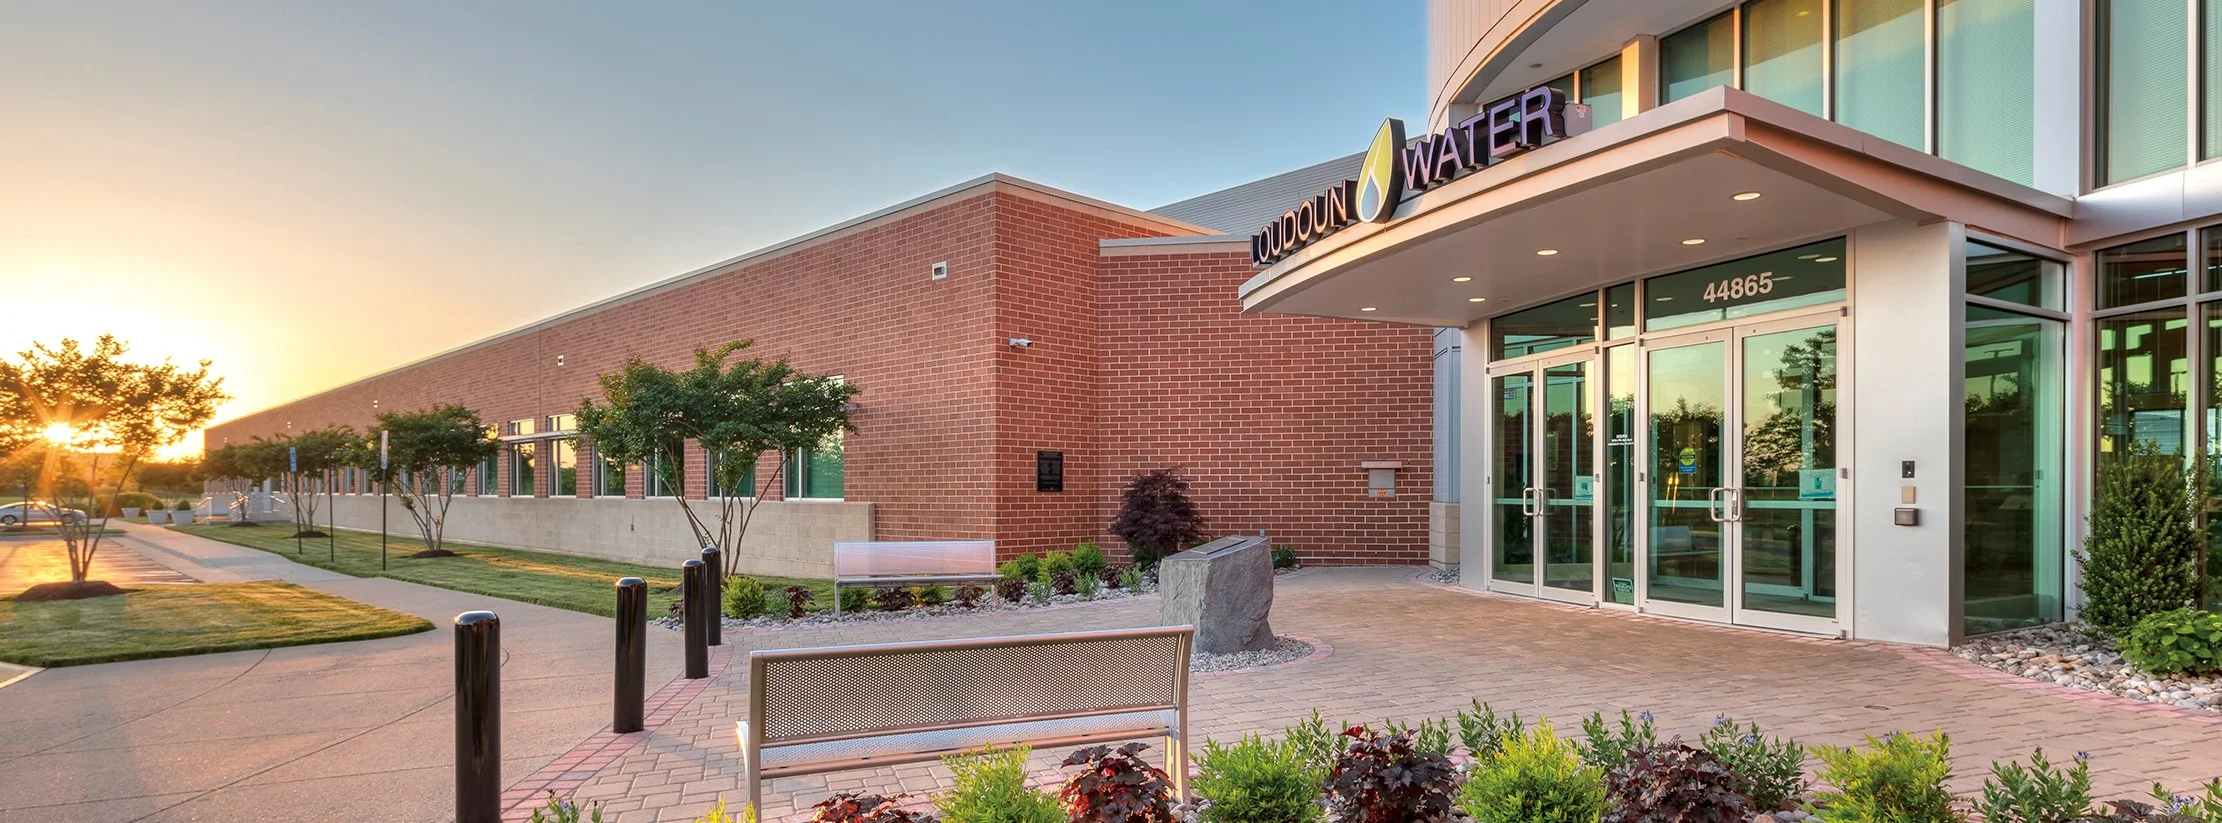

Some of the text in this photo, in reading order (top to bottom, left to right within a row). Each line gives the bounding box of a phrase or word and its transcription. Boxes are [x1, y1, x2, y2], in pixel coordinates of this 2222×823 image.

[1251, 86, 1553, 268] LOUDOUN WATER
[1703, 271, 1773, 303] 44865
